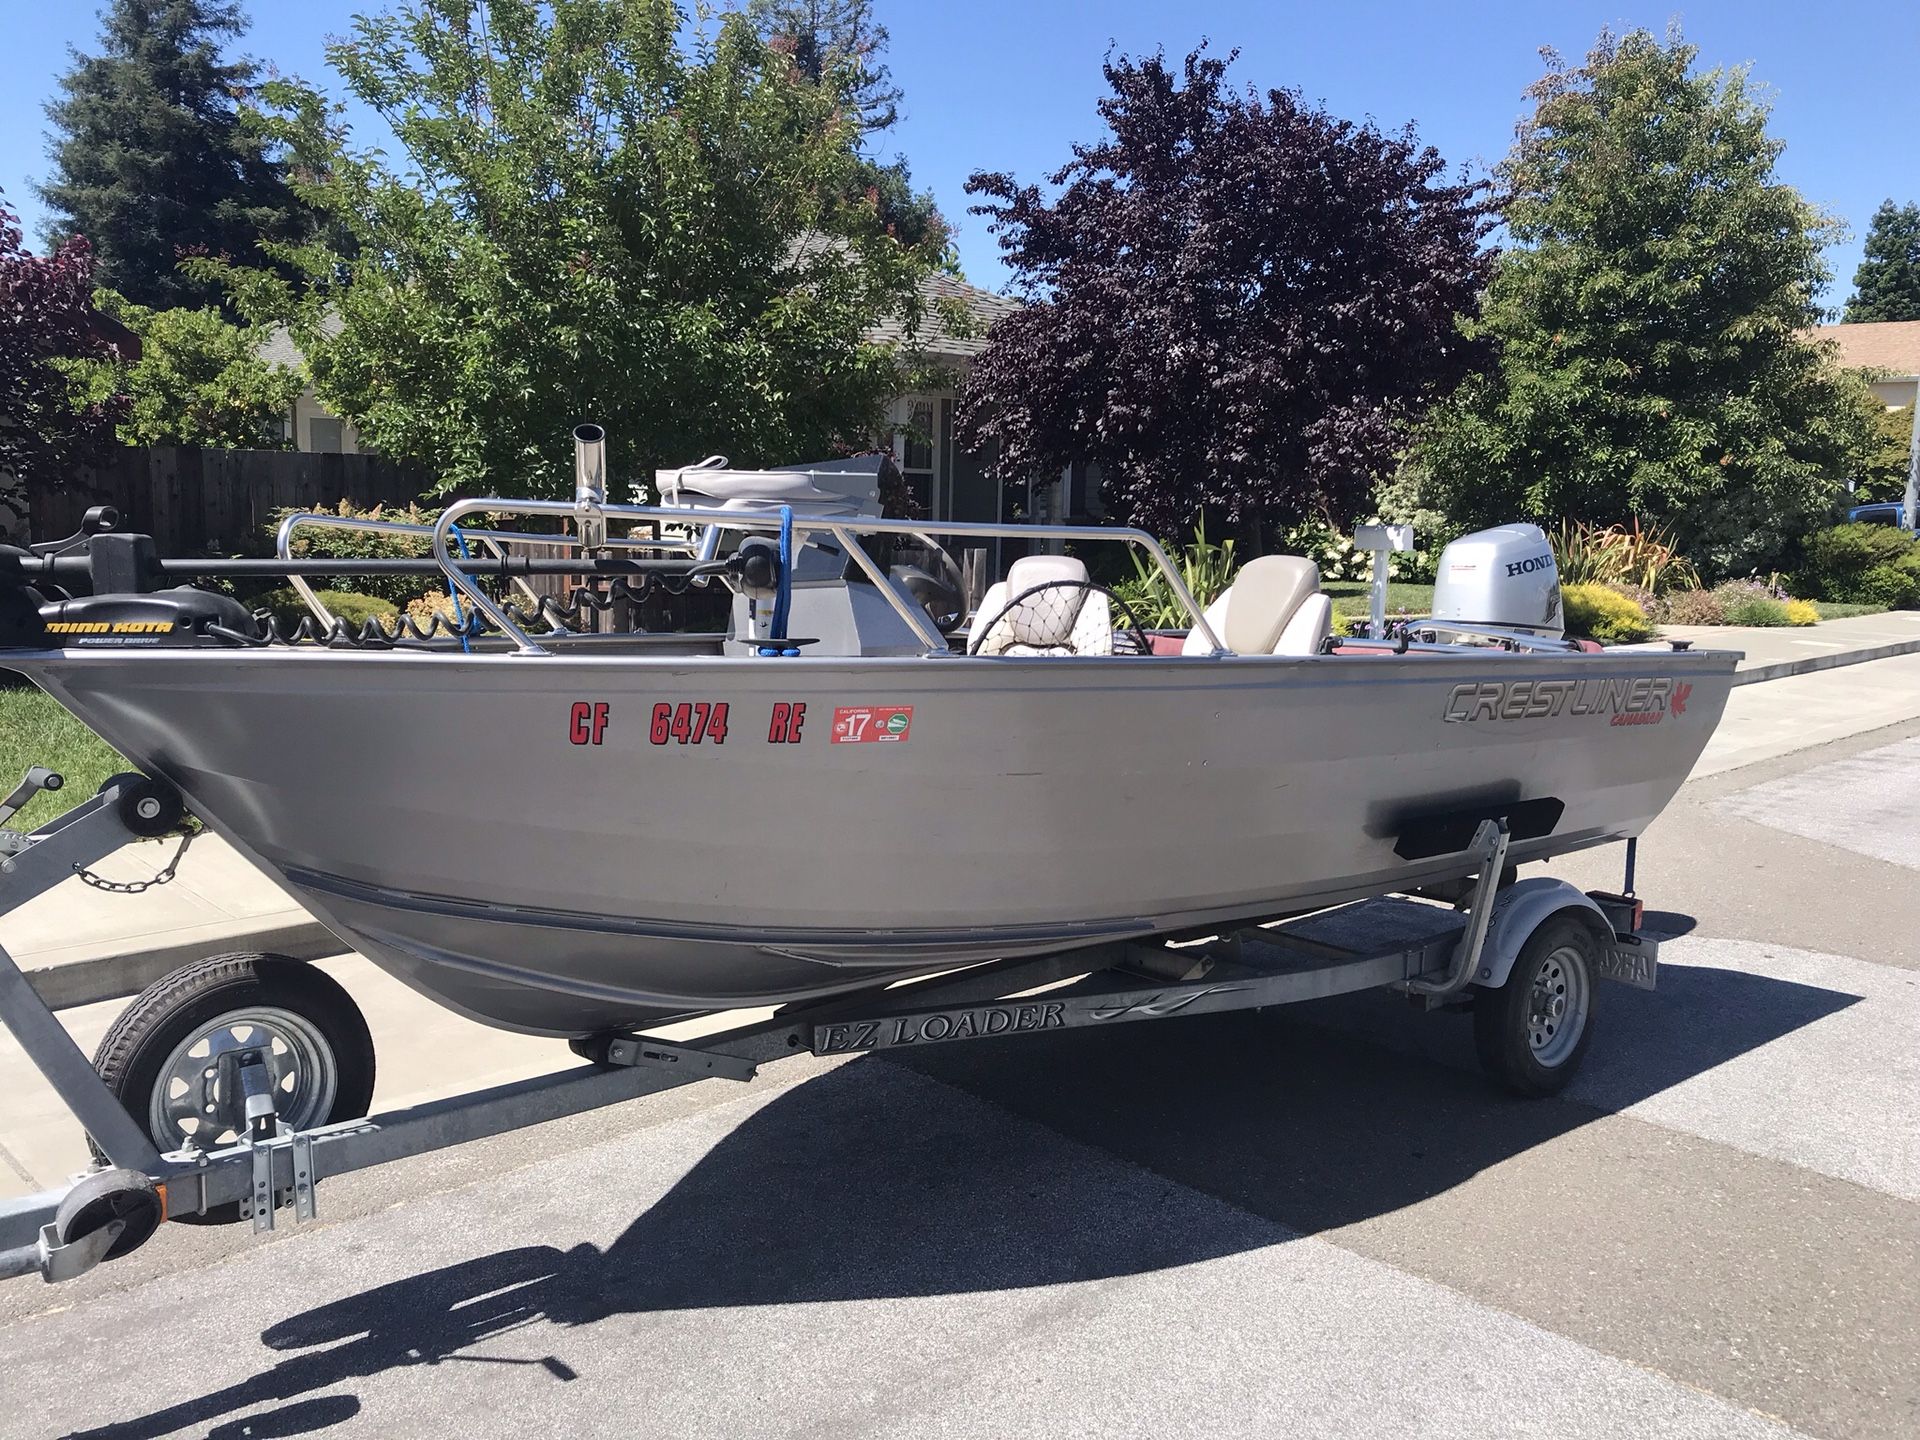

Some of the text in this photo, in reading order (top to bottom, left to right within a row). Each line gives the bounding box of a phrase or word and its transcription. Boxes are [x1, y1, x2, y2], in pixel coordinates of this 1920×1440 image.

[1505, 554, 1554, 577] HOND
[46, 622, 175, 633] MINN KOTA
[1443, 677, 1674, 723] CRESTLINER
[569, 702, 806, 745] CF 6474 RE
[845, 713, 872, 737] 17
[820, 1001, 1066, 1054] EZ LOADER
